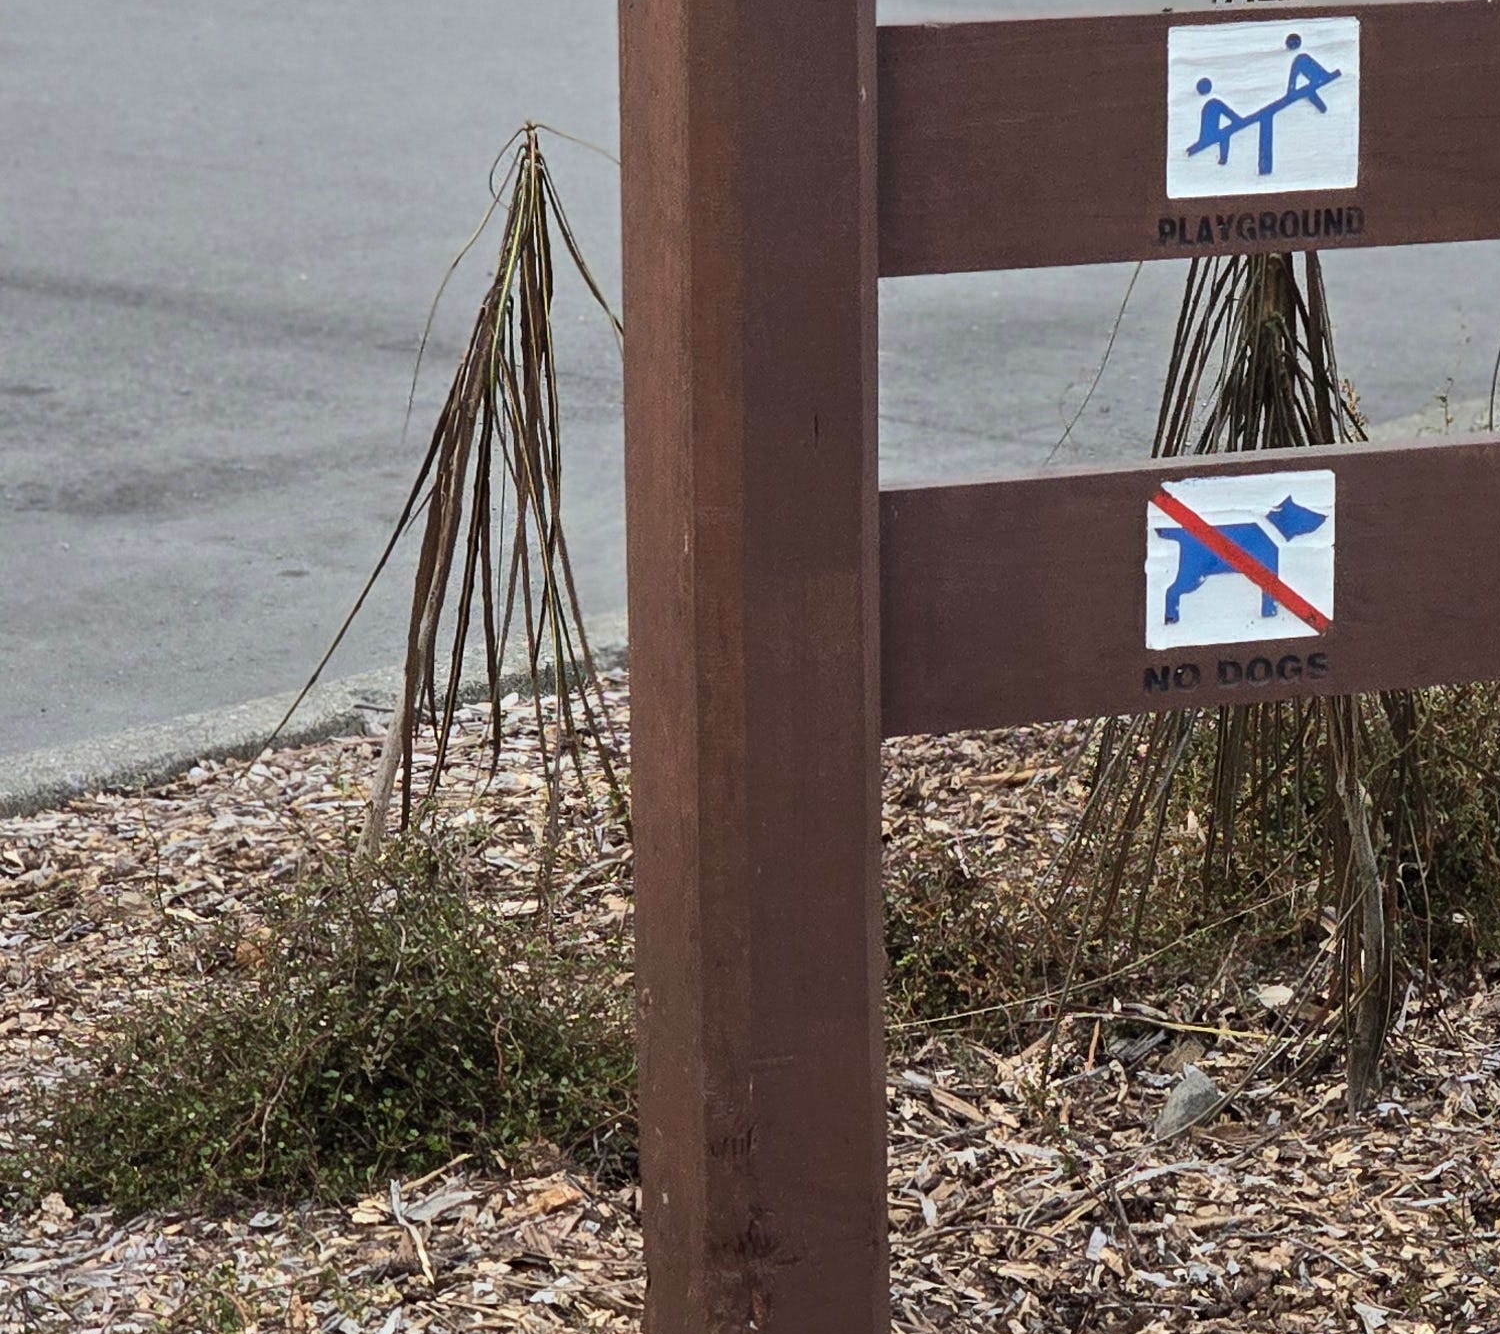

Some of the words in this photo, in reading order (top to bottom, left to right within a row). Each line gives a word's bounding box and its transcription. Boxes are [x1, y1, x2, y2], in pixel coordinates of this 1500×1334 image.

[1157, 206, 1366, 247] PLAYGROUND
[1142, 663, 1200, 693] NO
[1216, 651, 1329, 688] DOGS
